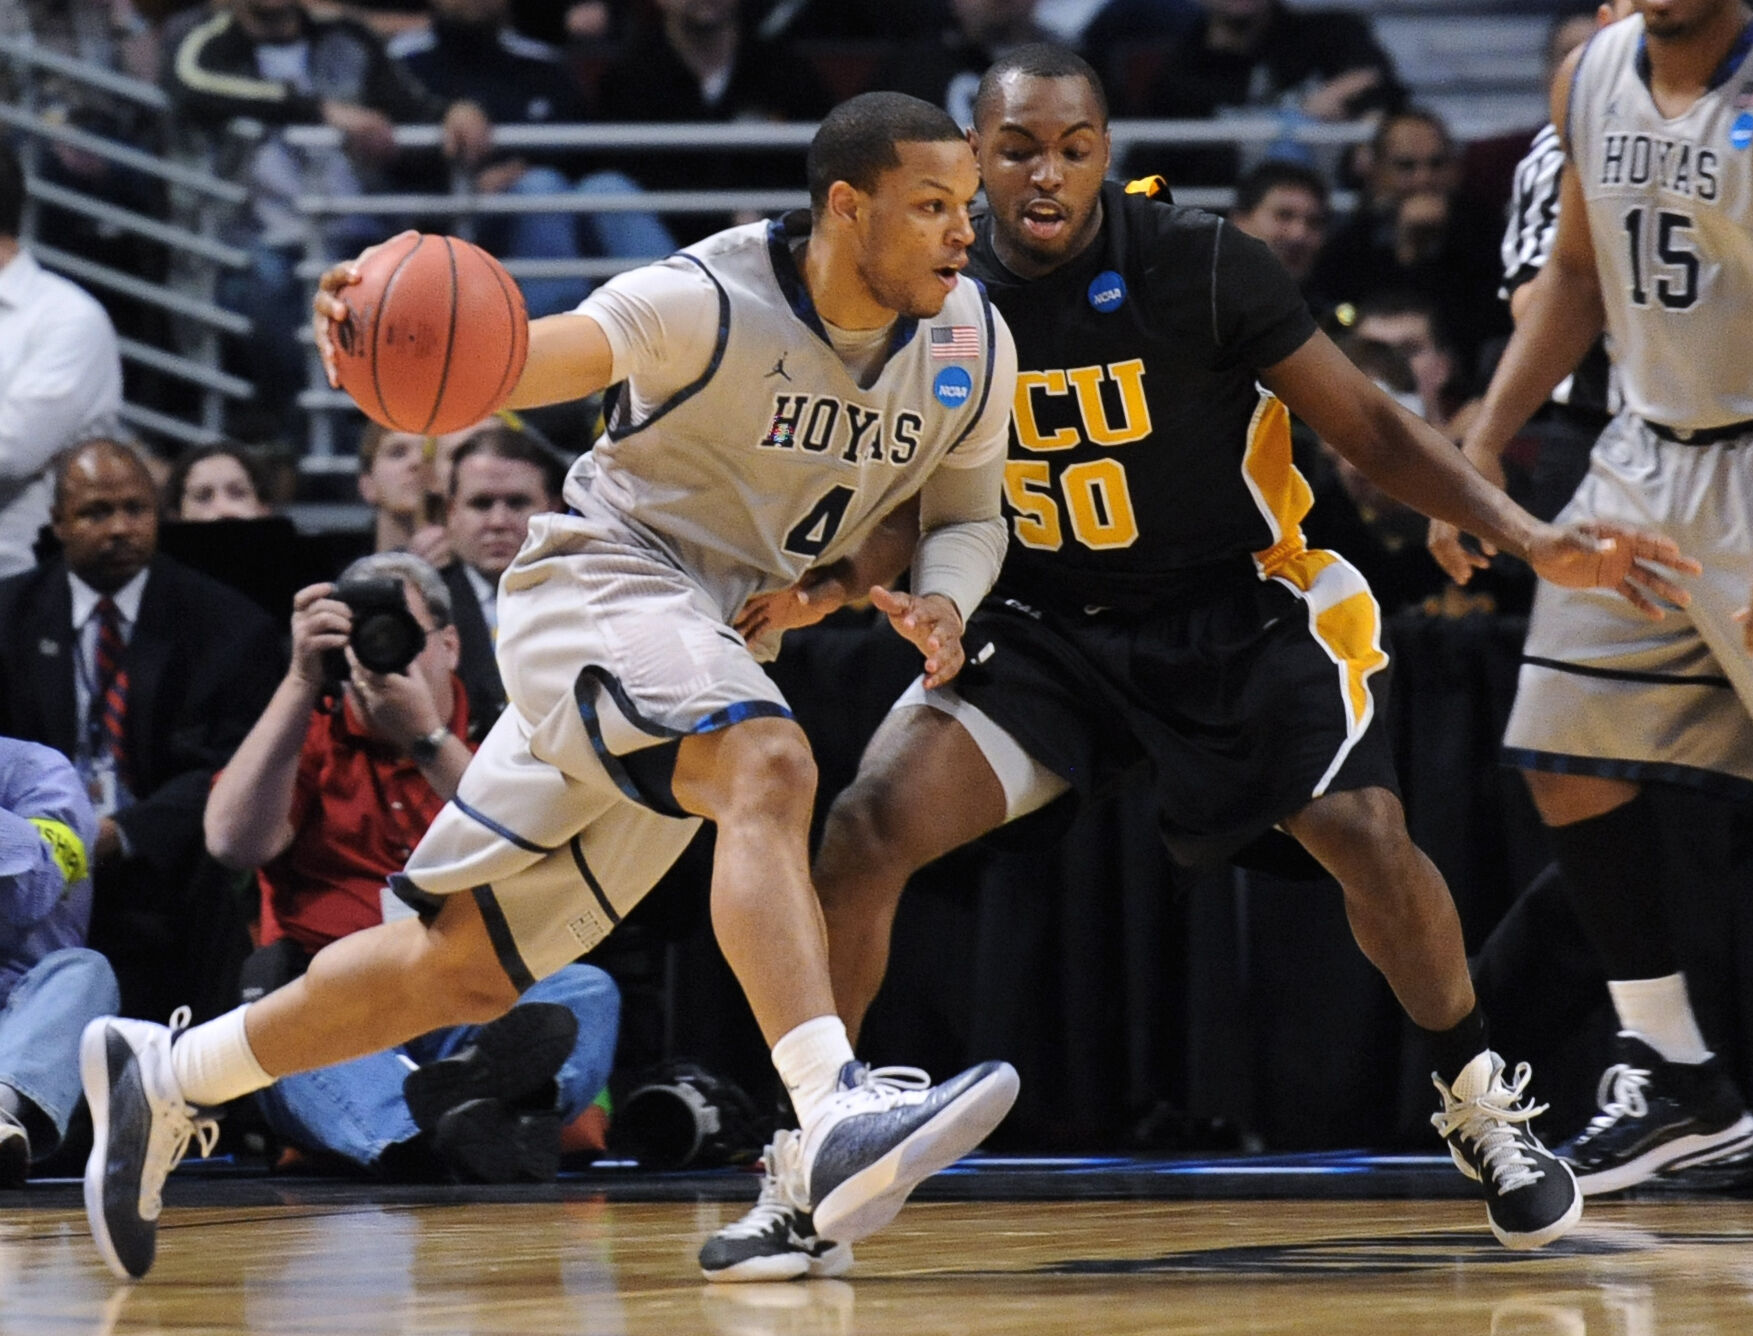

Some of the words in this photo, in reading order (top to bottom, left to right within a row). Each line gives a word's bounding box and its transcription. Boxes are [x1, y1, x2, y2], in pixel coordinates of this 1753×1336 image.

[1599, 132, 1719, 203] HOYAS
[1623, 206, 1701, 311] 15
[1094, 288, 1122, 304] NCAA
[939, 384, 968, 398] NCAA
[757, 392, 925, 466] HOYAS
[781, 482, 859, 560] 4
[1003, 457, 1139, 551] 50
